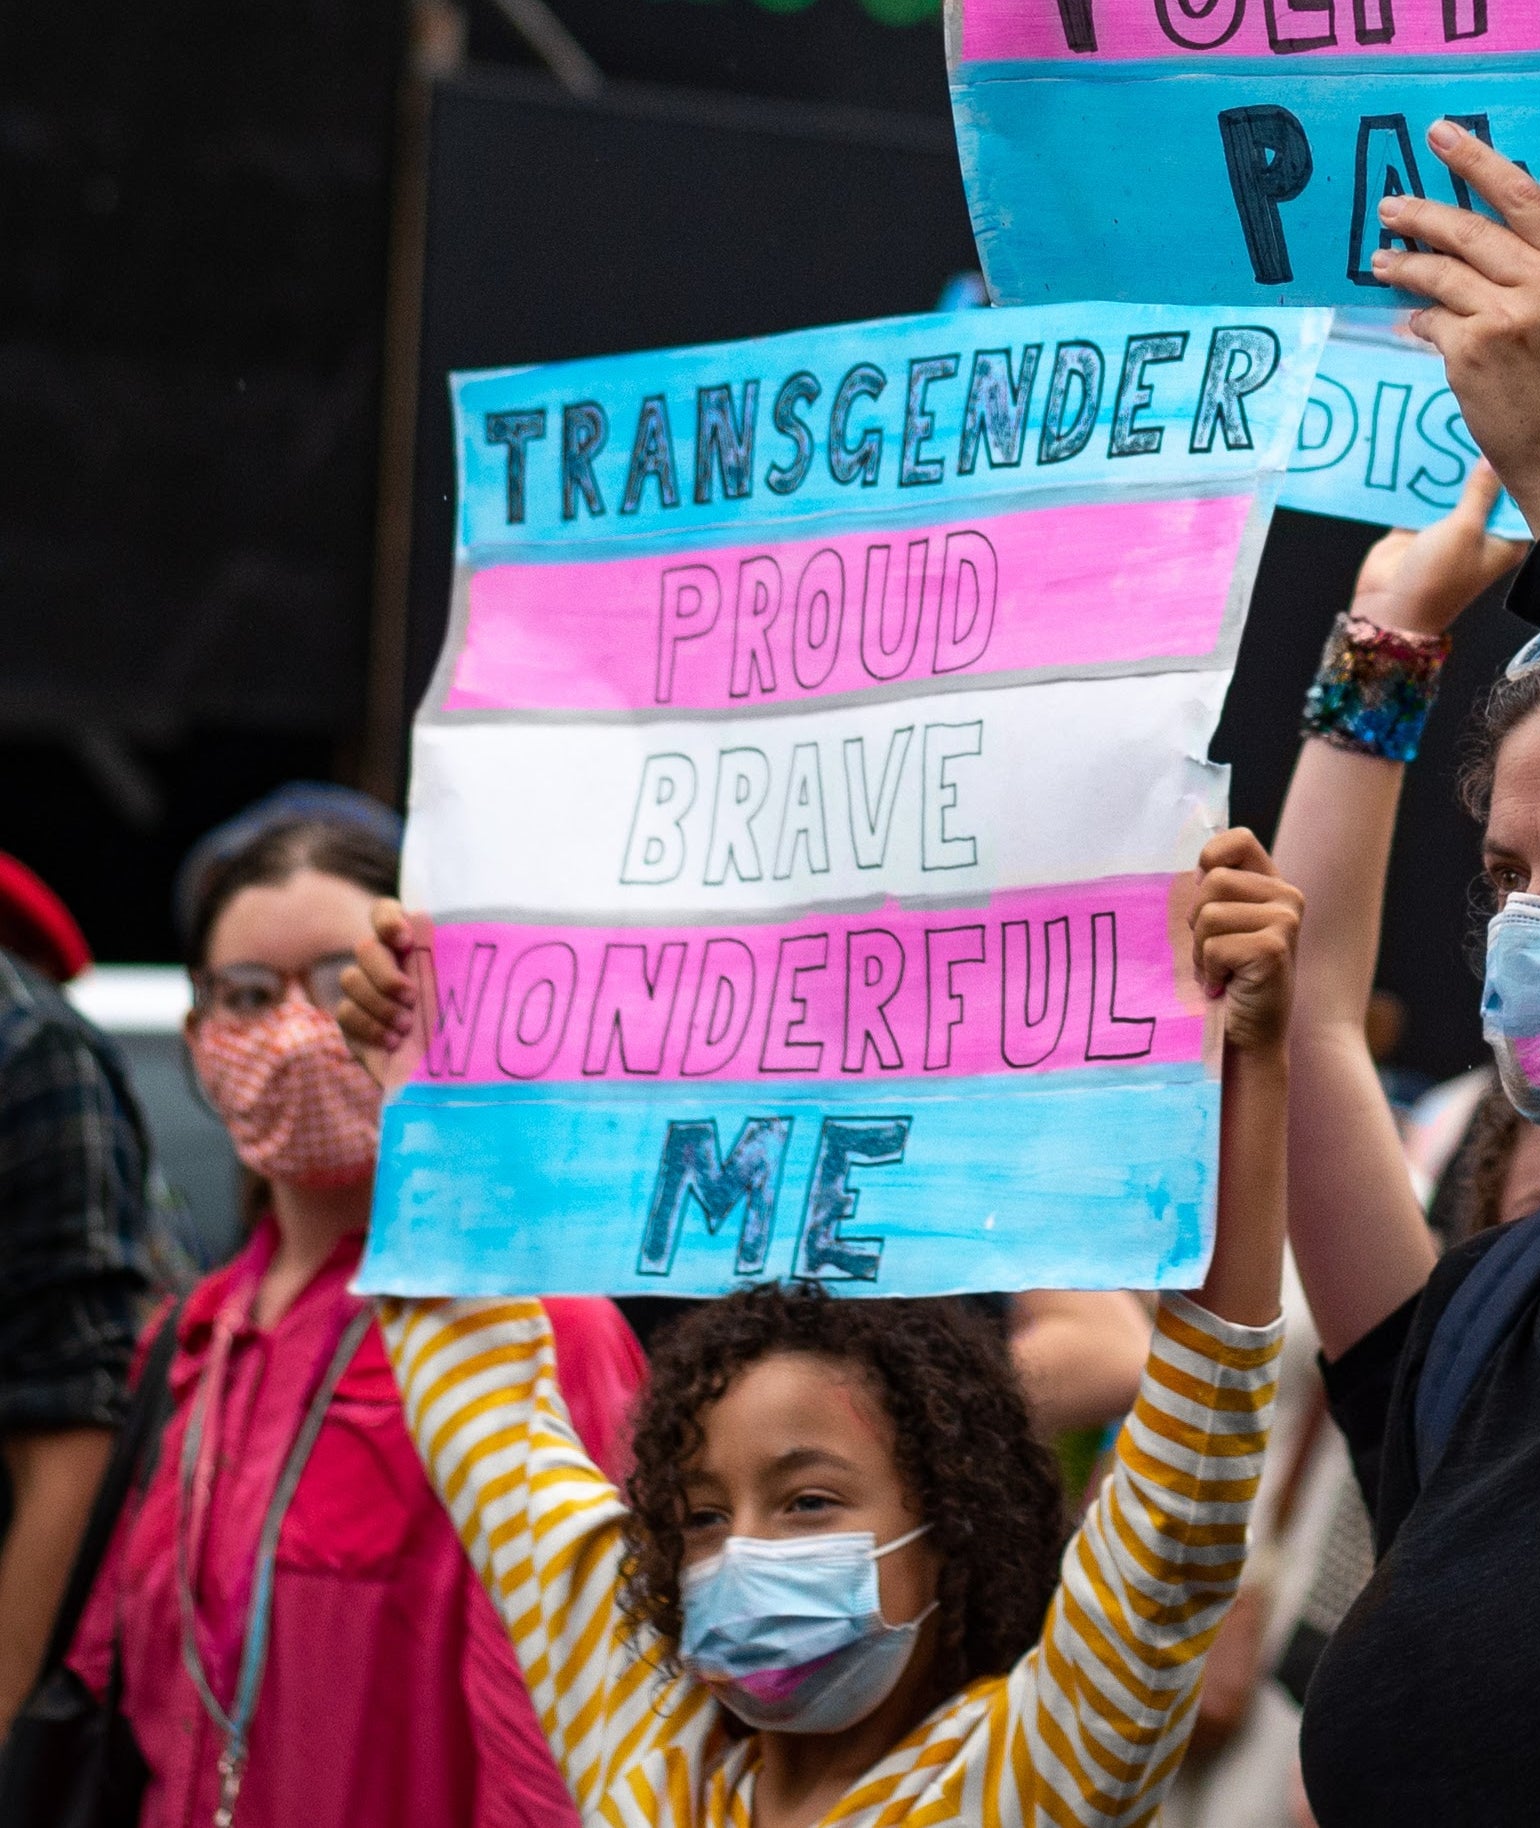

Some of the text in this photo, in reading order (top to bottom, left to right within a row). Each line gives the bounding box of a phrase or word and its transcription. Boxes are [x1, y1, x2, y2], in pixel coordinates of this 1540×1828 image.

[486, 325, 1282, 526] TRANSGENDER
[654, 530, 998, 704] PROUD
[620, 720, 984, 886] BRAVE
[412, 912, 1156, 1080] WONDERFUL
[636, 1115, 913, 1282] ME
